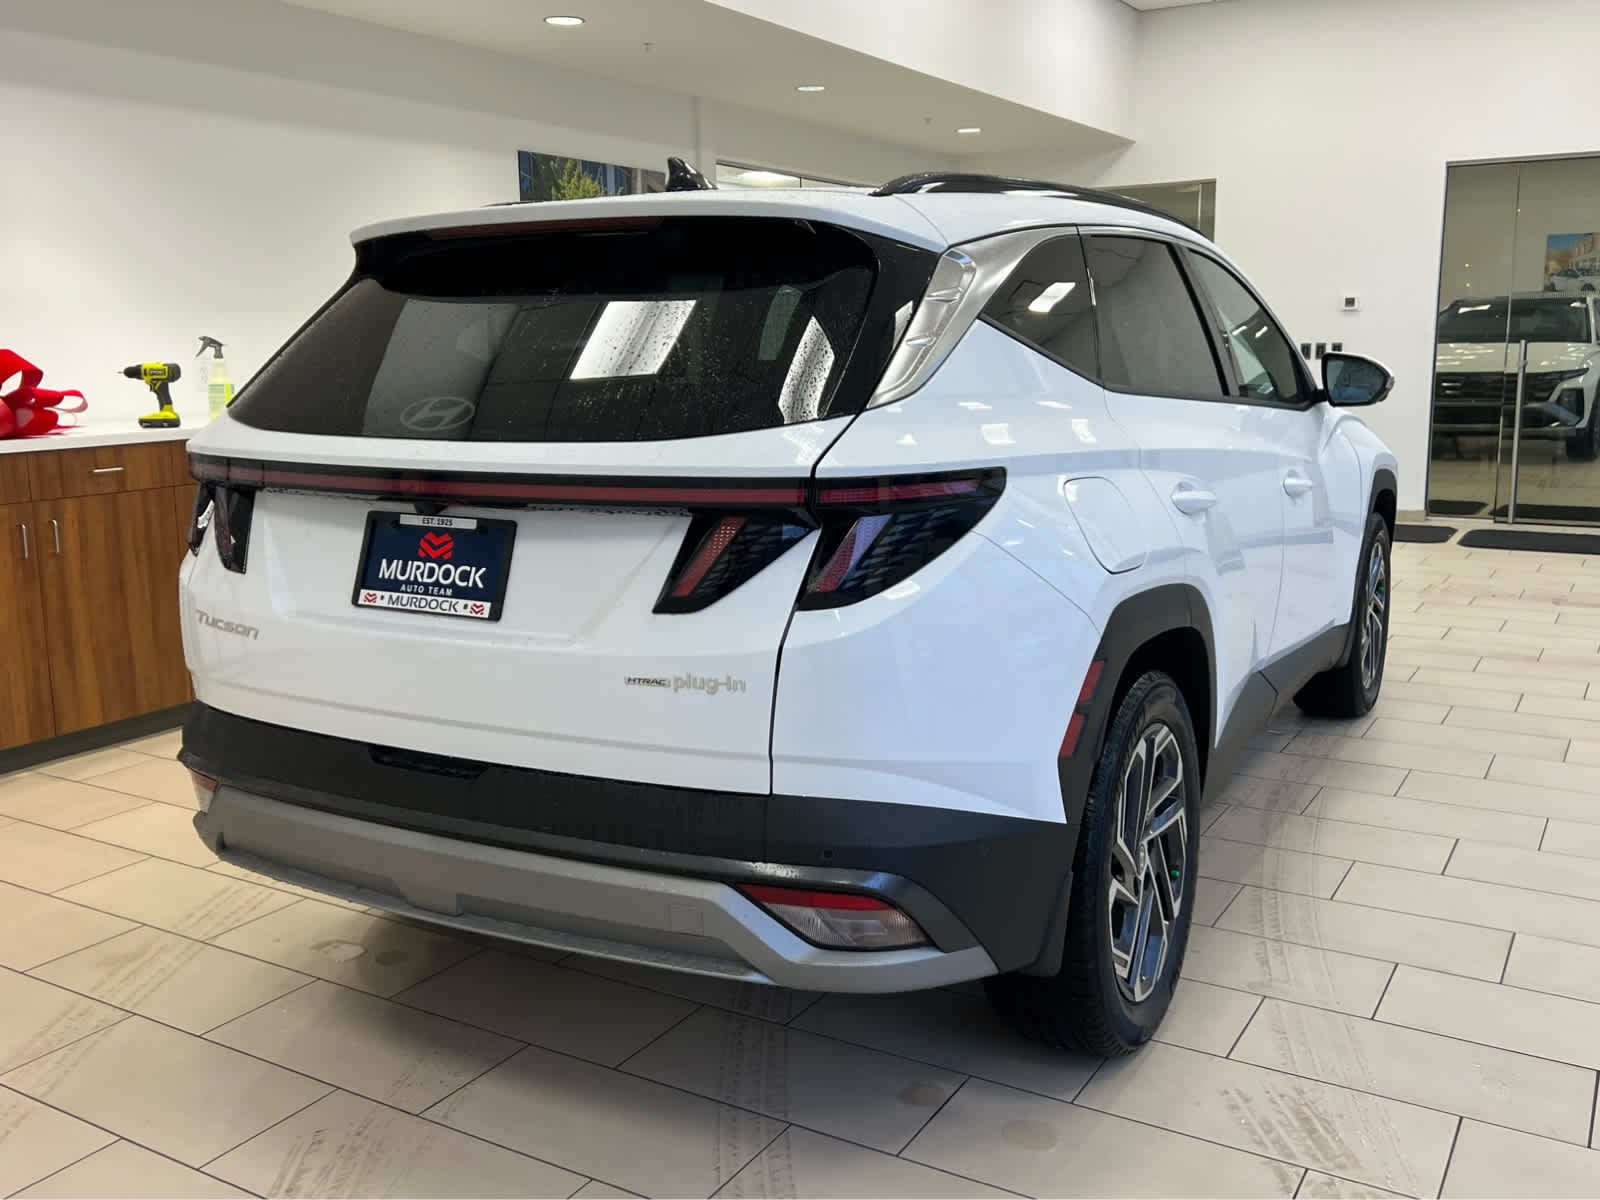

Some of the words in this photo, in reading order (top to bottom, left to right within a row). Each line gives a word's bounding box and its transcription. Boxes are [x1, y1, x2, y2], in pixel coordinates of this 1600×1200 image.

[422, 517, 436, 526] EST.
[378, 558, 487, 589] MURDOCK
[400, 584, 425, 594] AUTO
[428, 586, 453, 597] TEAM
[387, 594, 460, 613] MURDOCK
[673, 672, 747, 695] plug-in
